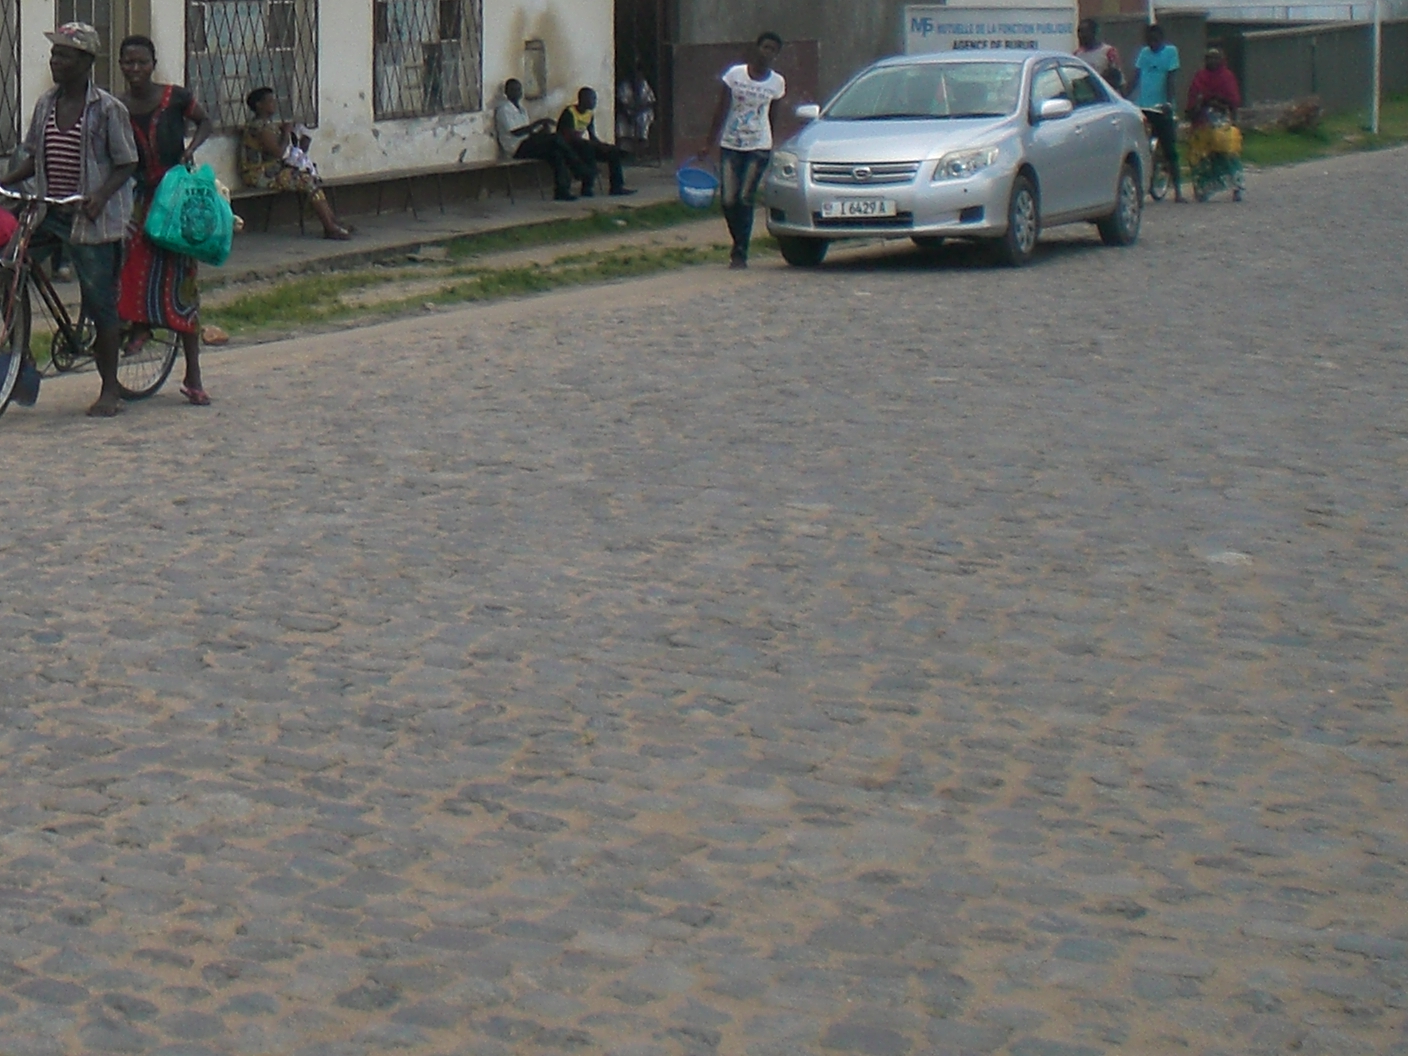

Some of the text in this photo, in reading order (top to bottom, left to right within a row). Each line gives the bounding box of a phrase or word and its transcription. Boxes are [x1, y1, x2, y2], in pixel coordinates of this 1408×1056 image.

[937, 23, 1073, 34] MUTUELLE DE LA FONCTION PUBLIQUE
[952, 40, 988, 50] AGENCE
[990, 40, 1001, 50] DE
[849, 202, 876, 215] 6429
[879, 201, 885, 213] A
